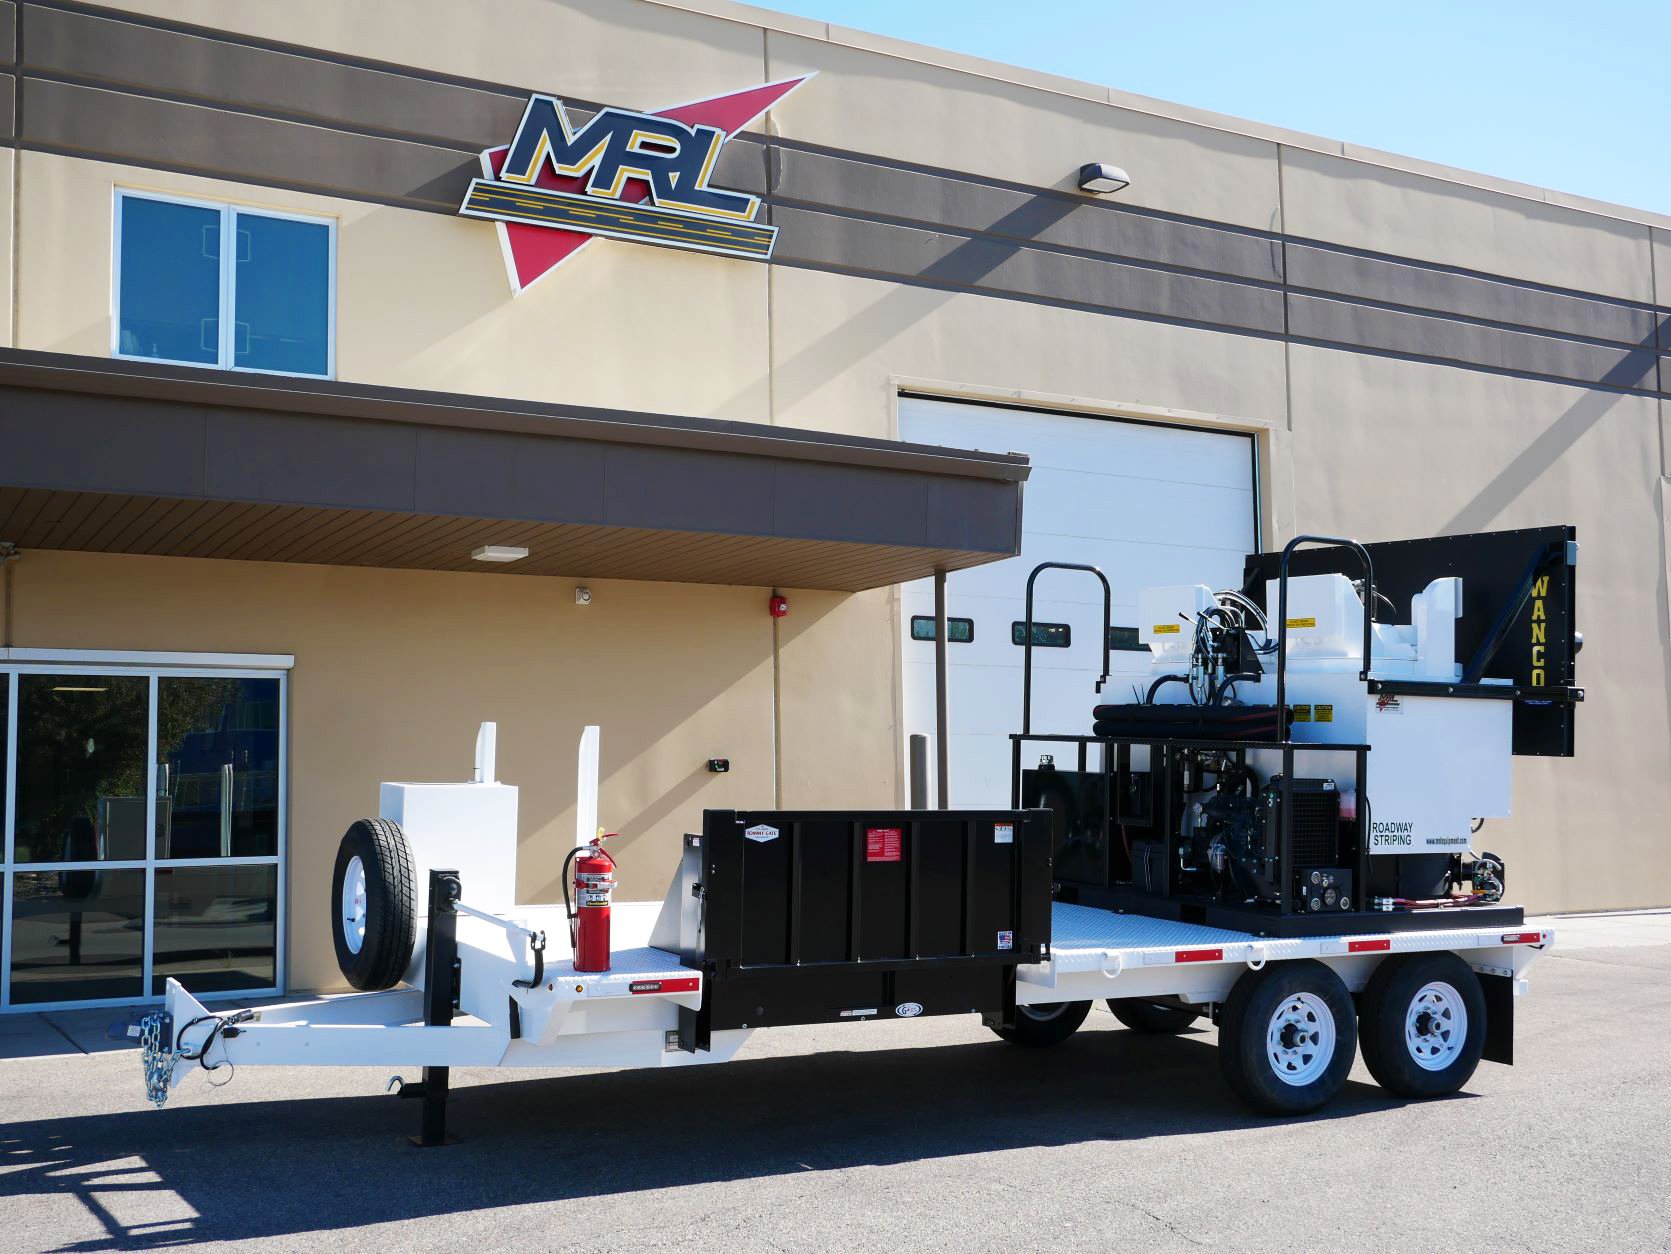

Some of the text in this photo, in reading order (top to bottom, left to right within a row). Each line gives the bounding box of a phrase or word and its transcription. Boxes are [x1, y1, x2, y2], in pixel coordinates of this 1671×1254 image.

[499, 94, 762, 221] MRL
[1531, 575, 1550, 687] WANCO
[1372, 822, 1414, 834] ROADWAY
[1373, 834, 1412, 846] STRIPING
